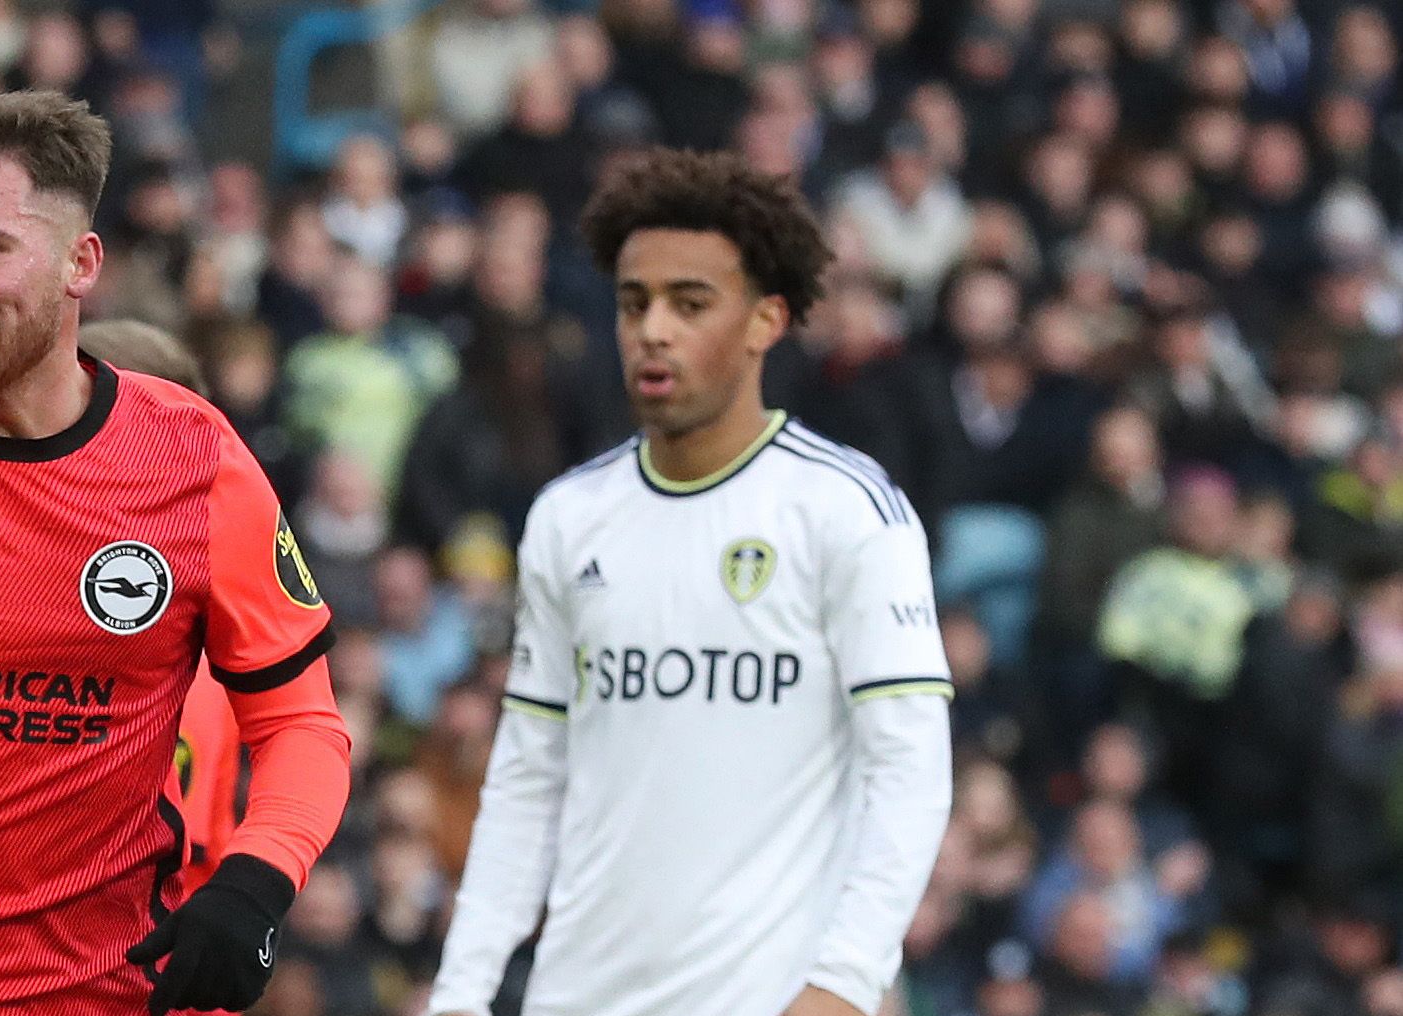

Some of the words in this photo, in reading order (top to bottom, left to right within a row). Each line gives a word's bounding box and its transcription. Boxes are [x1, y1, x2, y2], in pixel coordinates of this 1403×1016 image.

[96, 547, 138, 567] BRIGHTON
[104, 616, 137, 629] ALBION
[598, 648, 800, 703] SBOTOP
